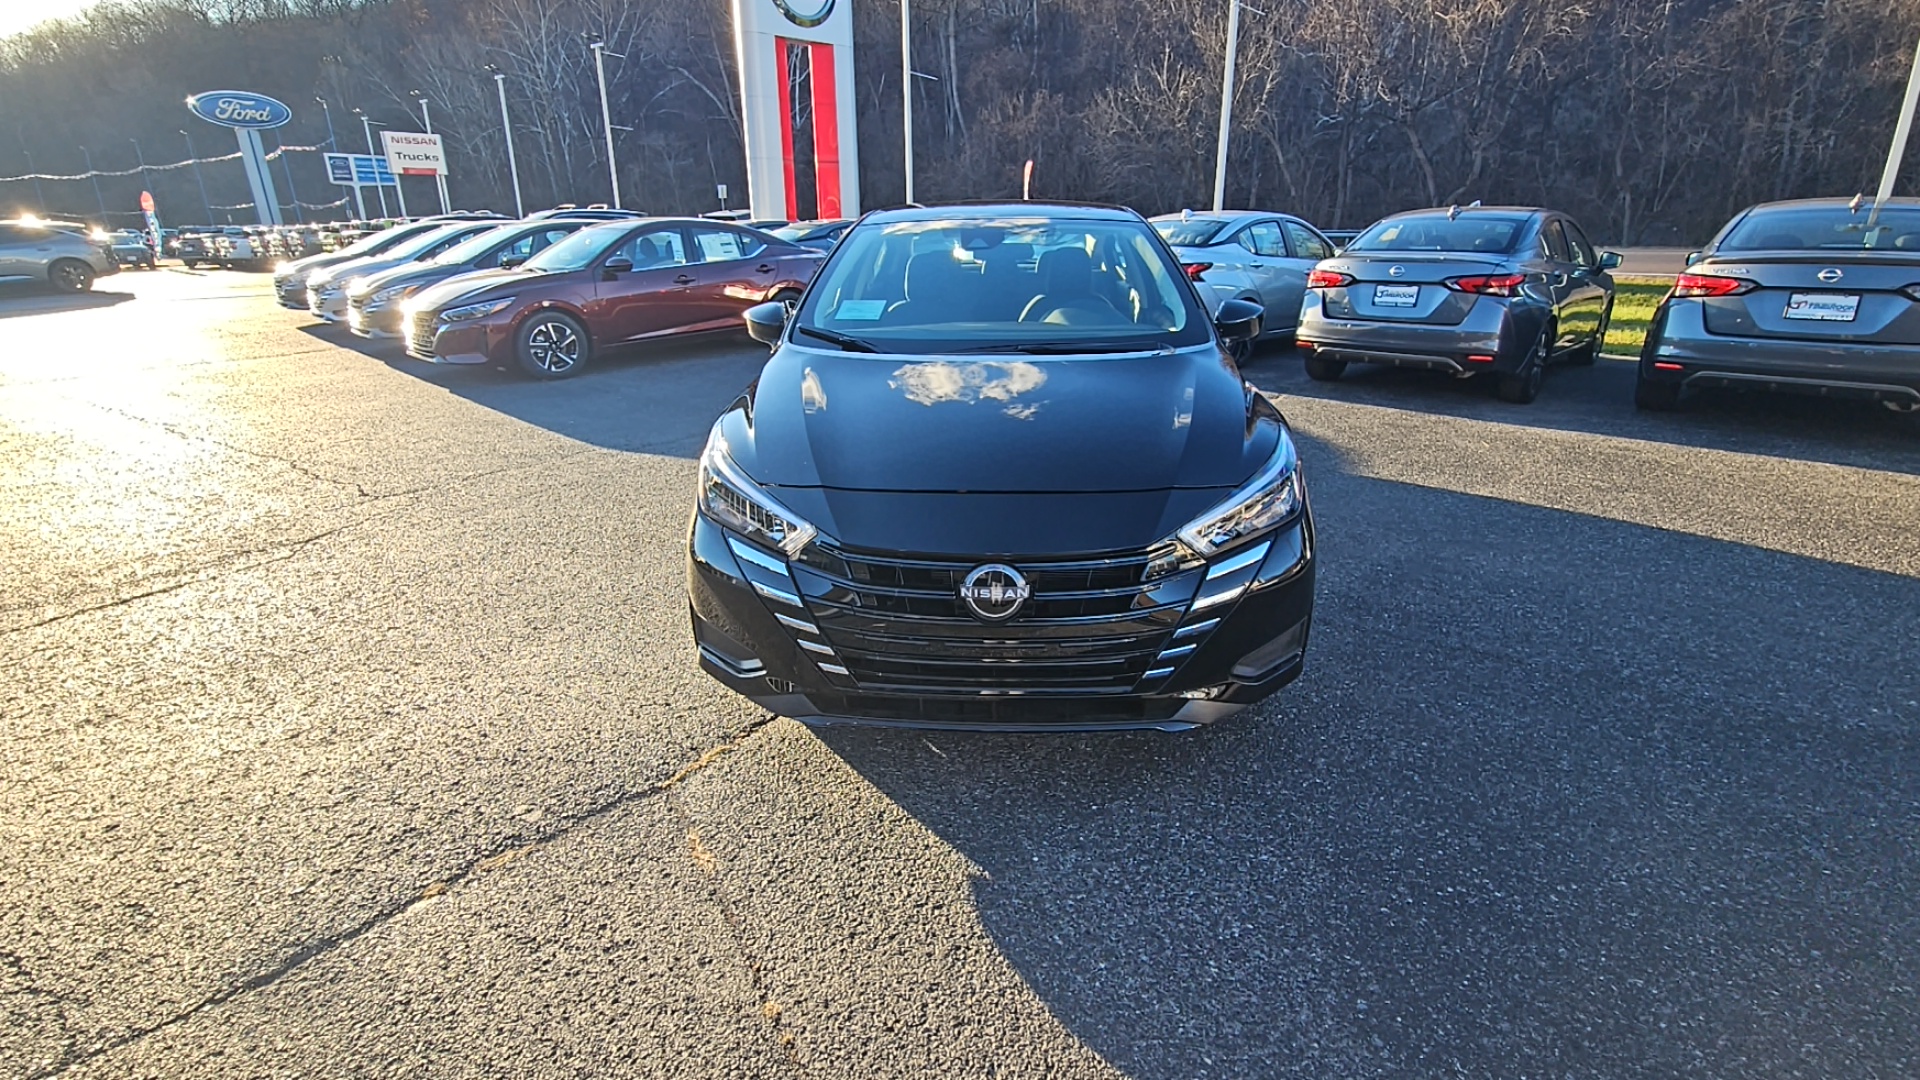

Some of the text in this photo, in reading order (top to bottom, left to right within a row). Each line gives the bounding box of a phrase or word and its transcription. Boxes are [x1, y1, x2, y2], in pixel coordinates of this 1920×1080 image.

[215, 98, 271, 121] Ford
[391, 136, 437, 145] NISSAN
[395, 152, 439, 162] Trucks
[961, 587, 1028, 598] NISSAN
